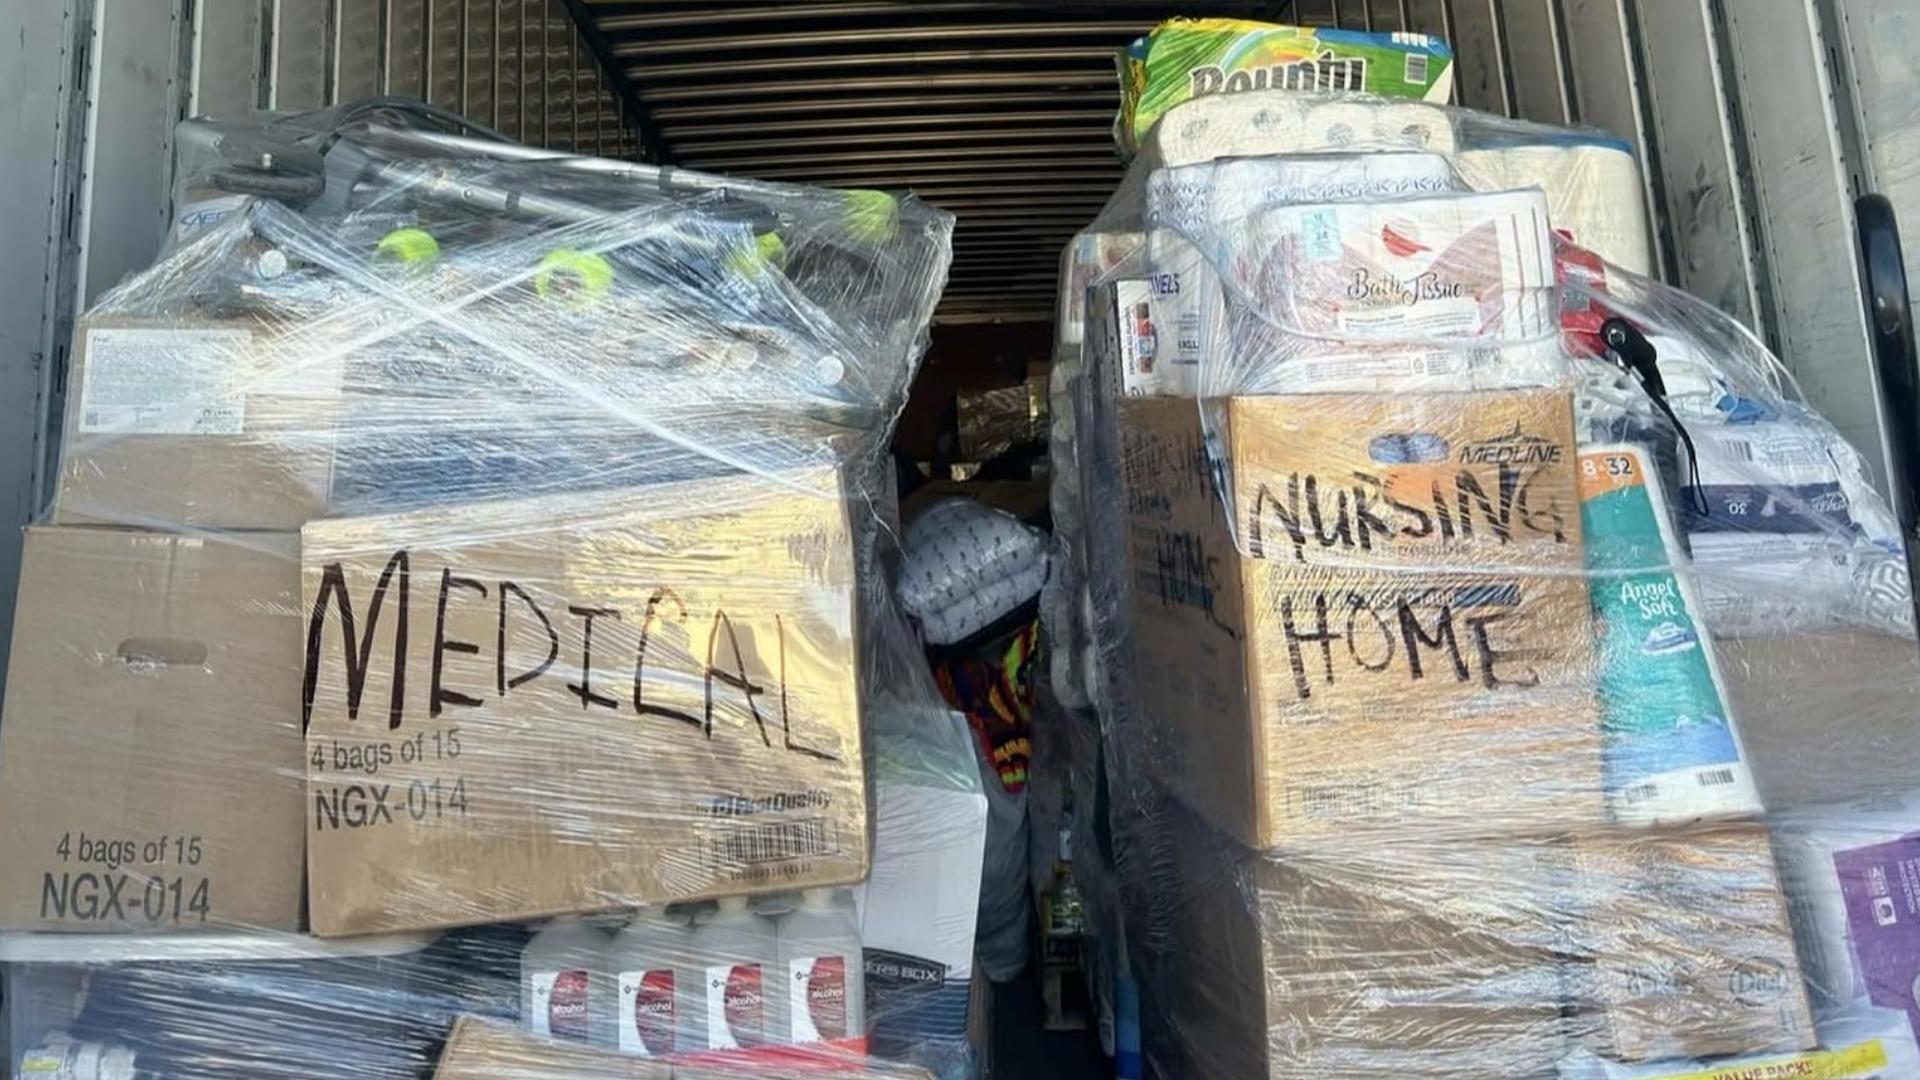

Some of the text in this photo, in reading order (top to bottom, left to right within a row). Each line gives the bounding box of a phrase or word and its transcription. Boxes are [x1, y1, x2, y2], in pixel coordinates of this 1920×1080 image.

[1348, 267, 1462, 307] Bath Tissue
[1460, 445, 1564, 464] MEDLINE
[1582, 456, 1633, 476] 8 32
[1250, 464, 1565, 563] NURSING
[1621, 578, 1677, 605] Angel
[1639, 597, 1678, 619] Soft
[302, 549, 839, 760] MEDICAL
[1280, 593, 1540, 699] HOME
[312, 729, 462, 774] 4 bags of 15
[315, 777, 469, 830] NGX-014
[56, 833, 201, 866] 4 bags of 15
[40, 872, 210, 922] NGX-014
[901, 966, 938, 981] BOX
